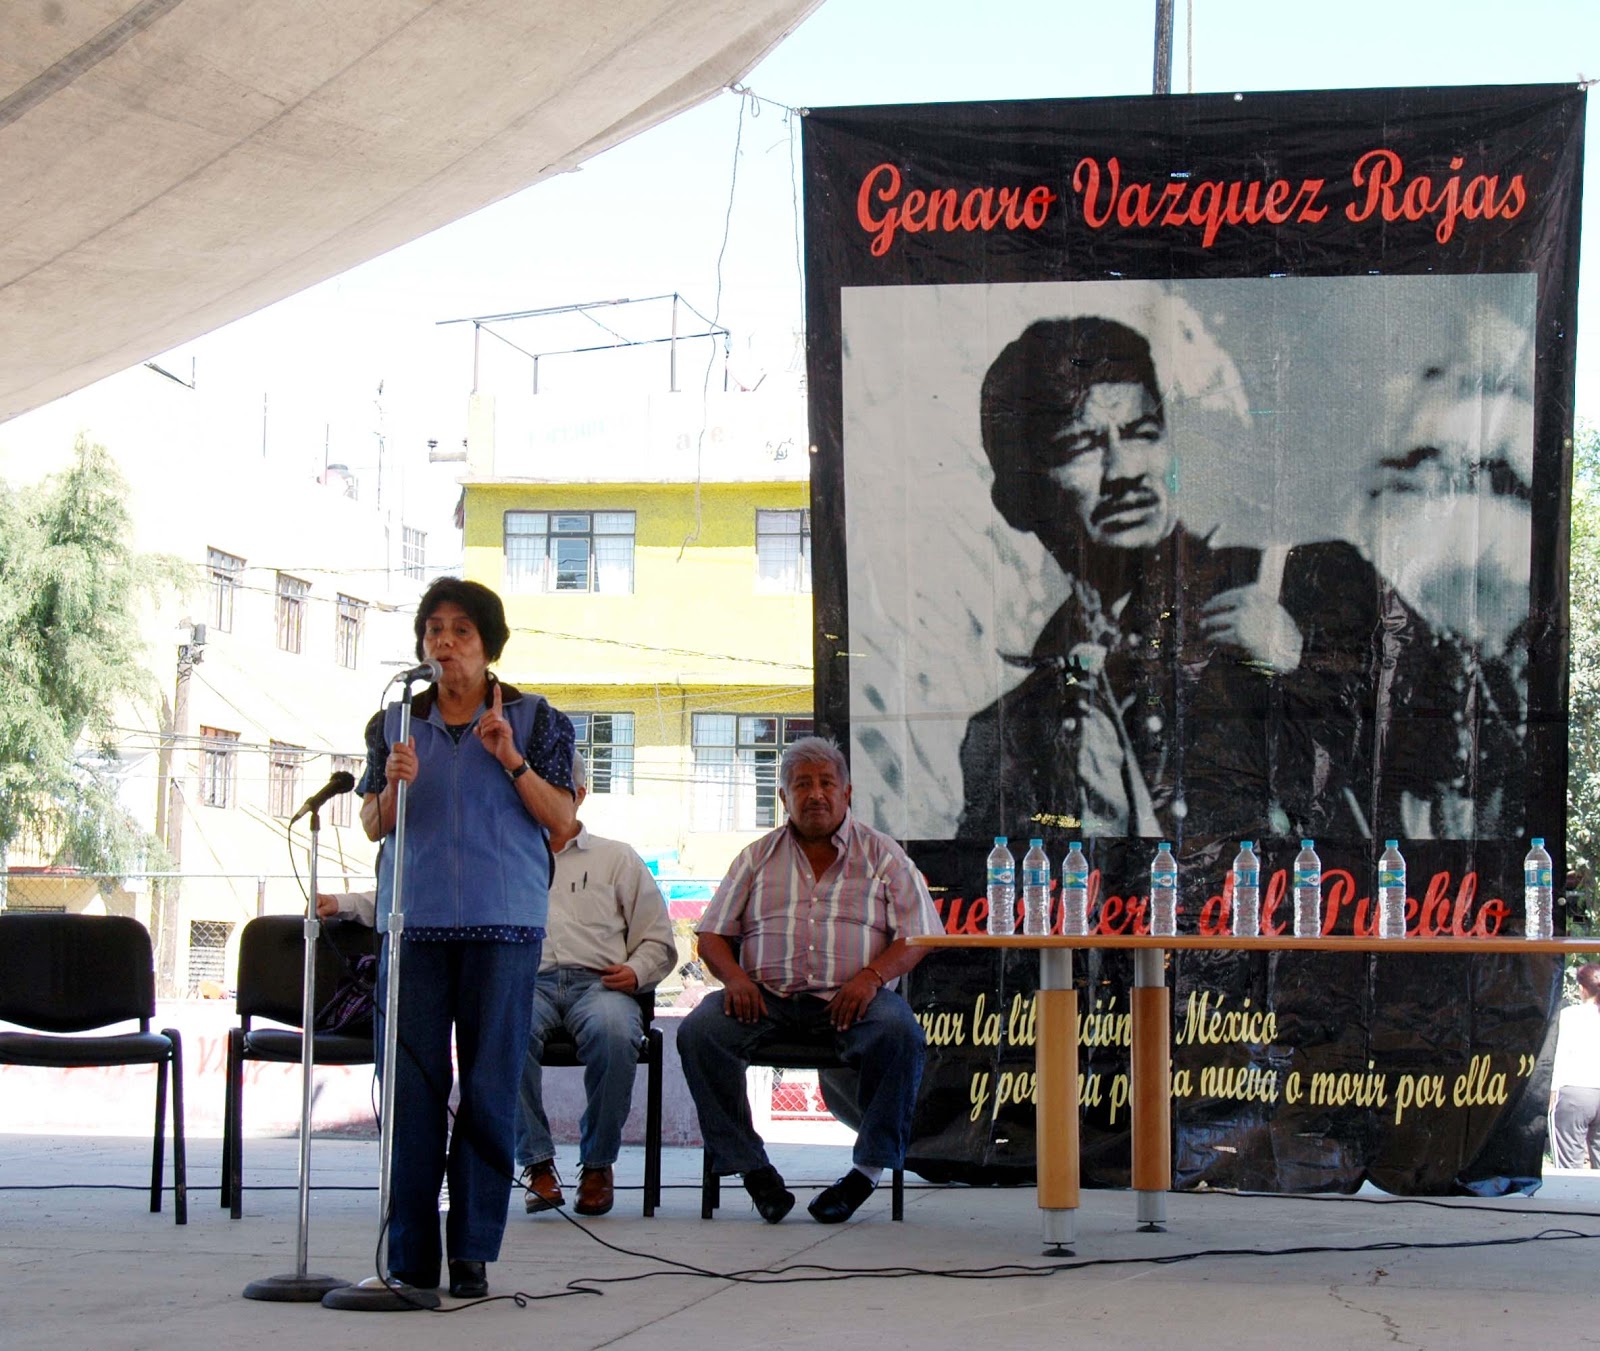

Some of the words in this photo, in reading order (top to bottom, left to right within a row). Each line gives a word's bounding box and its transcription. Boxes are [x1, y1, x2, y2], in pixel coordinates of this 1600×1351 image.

[857, 163, 1055, 257] Genaro
[1073, 157, 1328, 248] Vazquez
[1345, 149, 1526, 244] Rojas
[1199, 868, 1287, 936] dl
[972, 992, 1002, 1046] la
[1175, 990, 1278, 1046] México
[970, 1072, 989, 1122] y
[1200, 1065, 1278, 1102] nueva
[1285, 1070, 1303, 1105] o
[1309, 1060, 1388, 1107] morir
[1394, 1072, 1446, 1125] por
